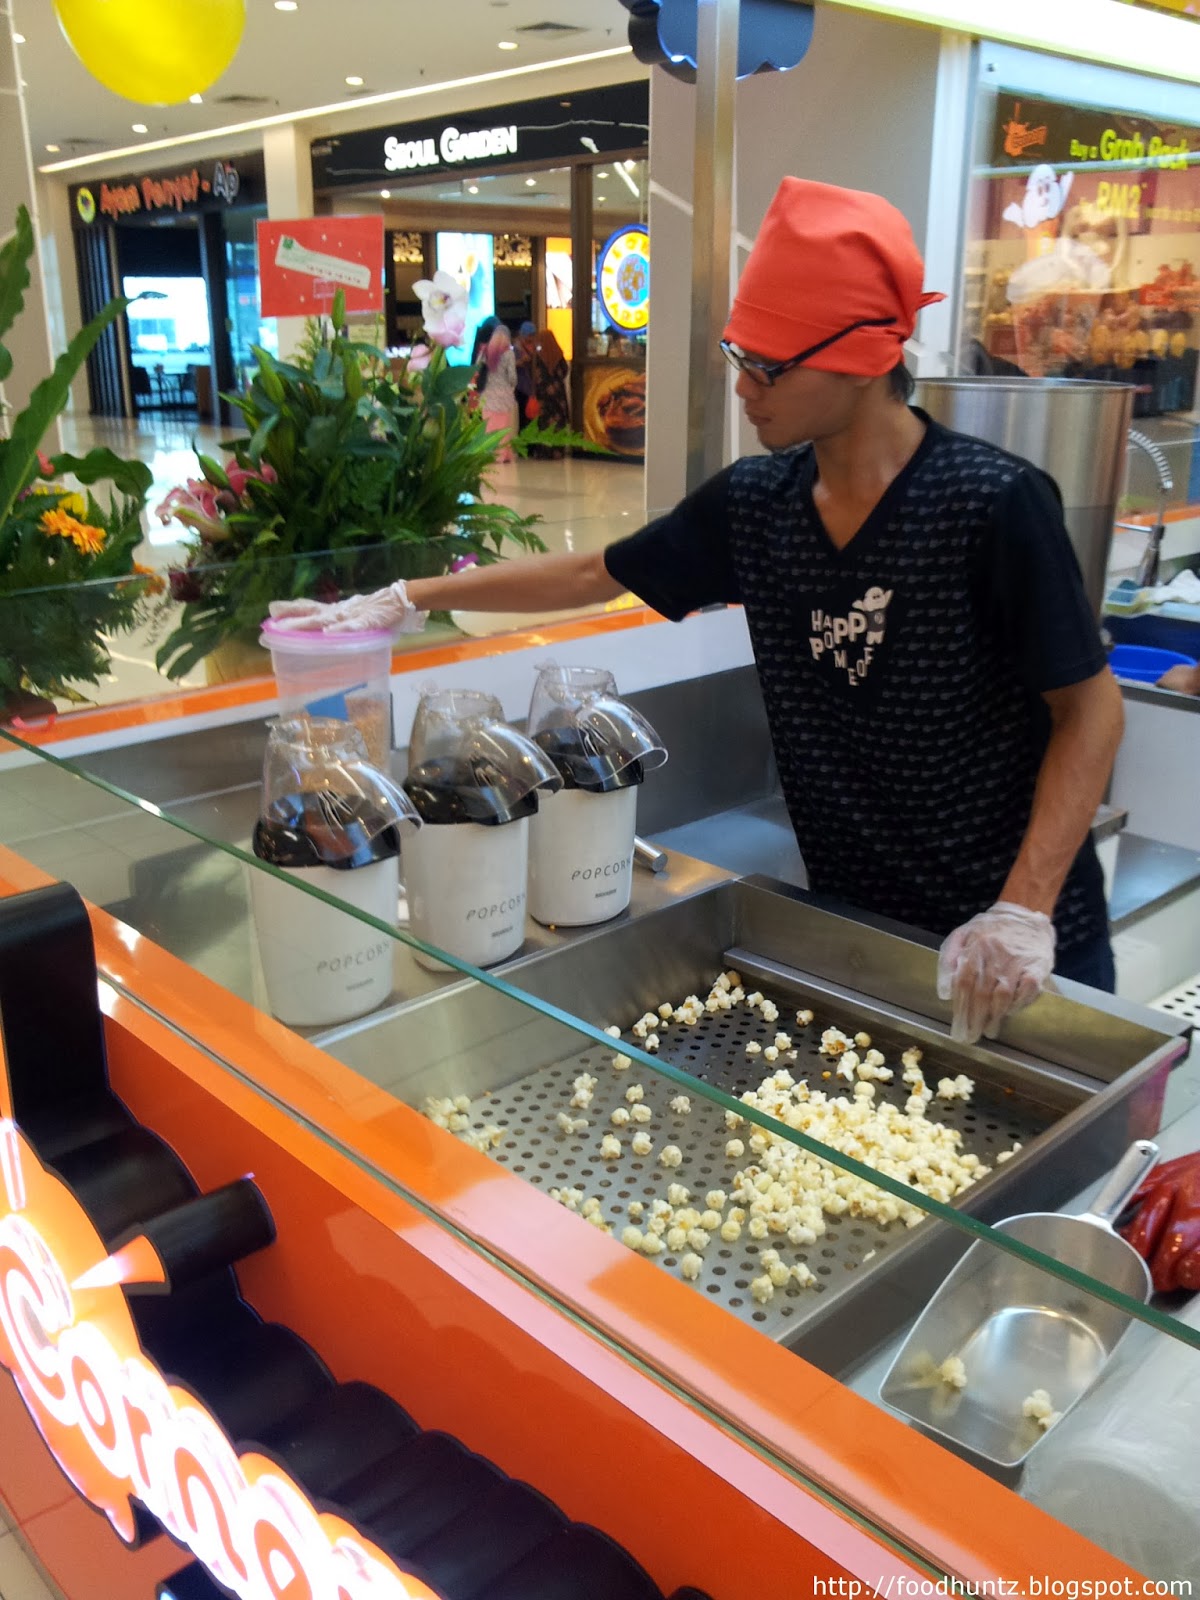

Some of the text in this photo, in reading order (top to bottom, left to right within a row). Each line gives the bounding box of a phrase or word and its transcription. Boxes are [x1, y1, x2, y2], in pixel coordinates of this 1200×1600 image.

[384, 127, 517, 171] SEOUL GARDEN
[1101, 129, 1144, 164] Grab
